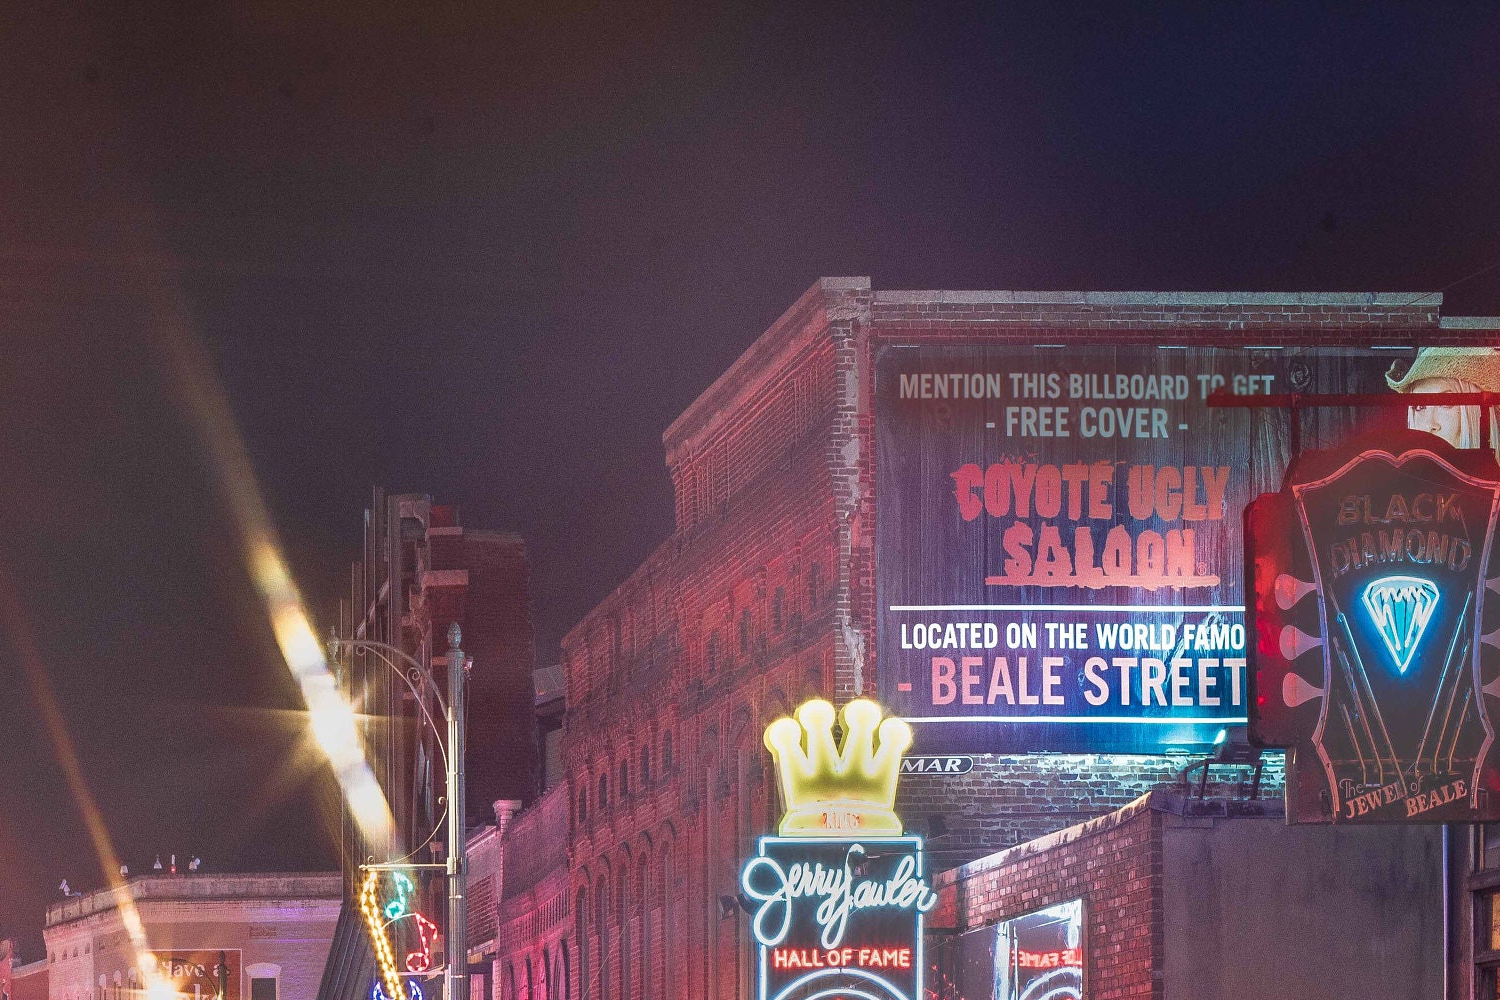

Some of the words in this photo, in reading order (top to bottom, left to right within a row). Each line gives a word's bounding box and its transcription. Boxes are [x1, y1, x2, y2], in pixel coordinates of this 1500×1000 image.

[900, 373, 1000, 399] MENTION
[1008, 373, 1061, 399] THIS
[1069, 374, 1189, 400] BILLBOARD
[1197, 374, 1225, 399] TO
[1233, 375, 1274, 396] GET
[1006, 406, 1070, 437] FREE
[1080, 407, 1169, 438] COVER
[950, 461, 1117, 521] COYOTE
[1128, 465, 1231, 521] UGLY
[1337, 493, 1461, 526] BLACK
[1003, 520, 1197, 577] SALOON
[1330, 527, 1472, 578] DIAMOND
[901, 623, 998, 650] LOCATED
[1006, 624, 1037, 649] ON
[1045, 624, 1089, 649] THE
[1095, 624, 1176, 650] WORLD
[1183, 624, 1245, 651] FAMO
[931, 656, 1064, 706] BEALE
[1083, 656, 1247, 707] STREET
[900, 757, 962, 773] MAR
[1339, 777, 1365, 799] The
[1345, 780, 1407, 820] JEWEL
[1405, 778, 1469, 818] BEALE
[1409, 774, 1424, 796] of
[742, 856, 842, 947] Jerry
[821, 843, 938, 950] Lawler
[774, 949, 824, 968] HALL
[827, 949, 852, 967] OF
[858, 949, 911, 968] FAME
